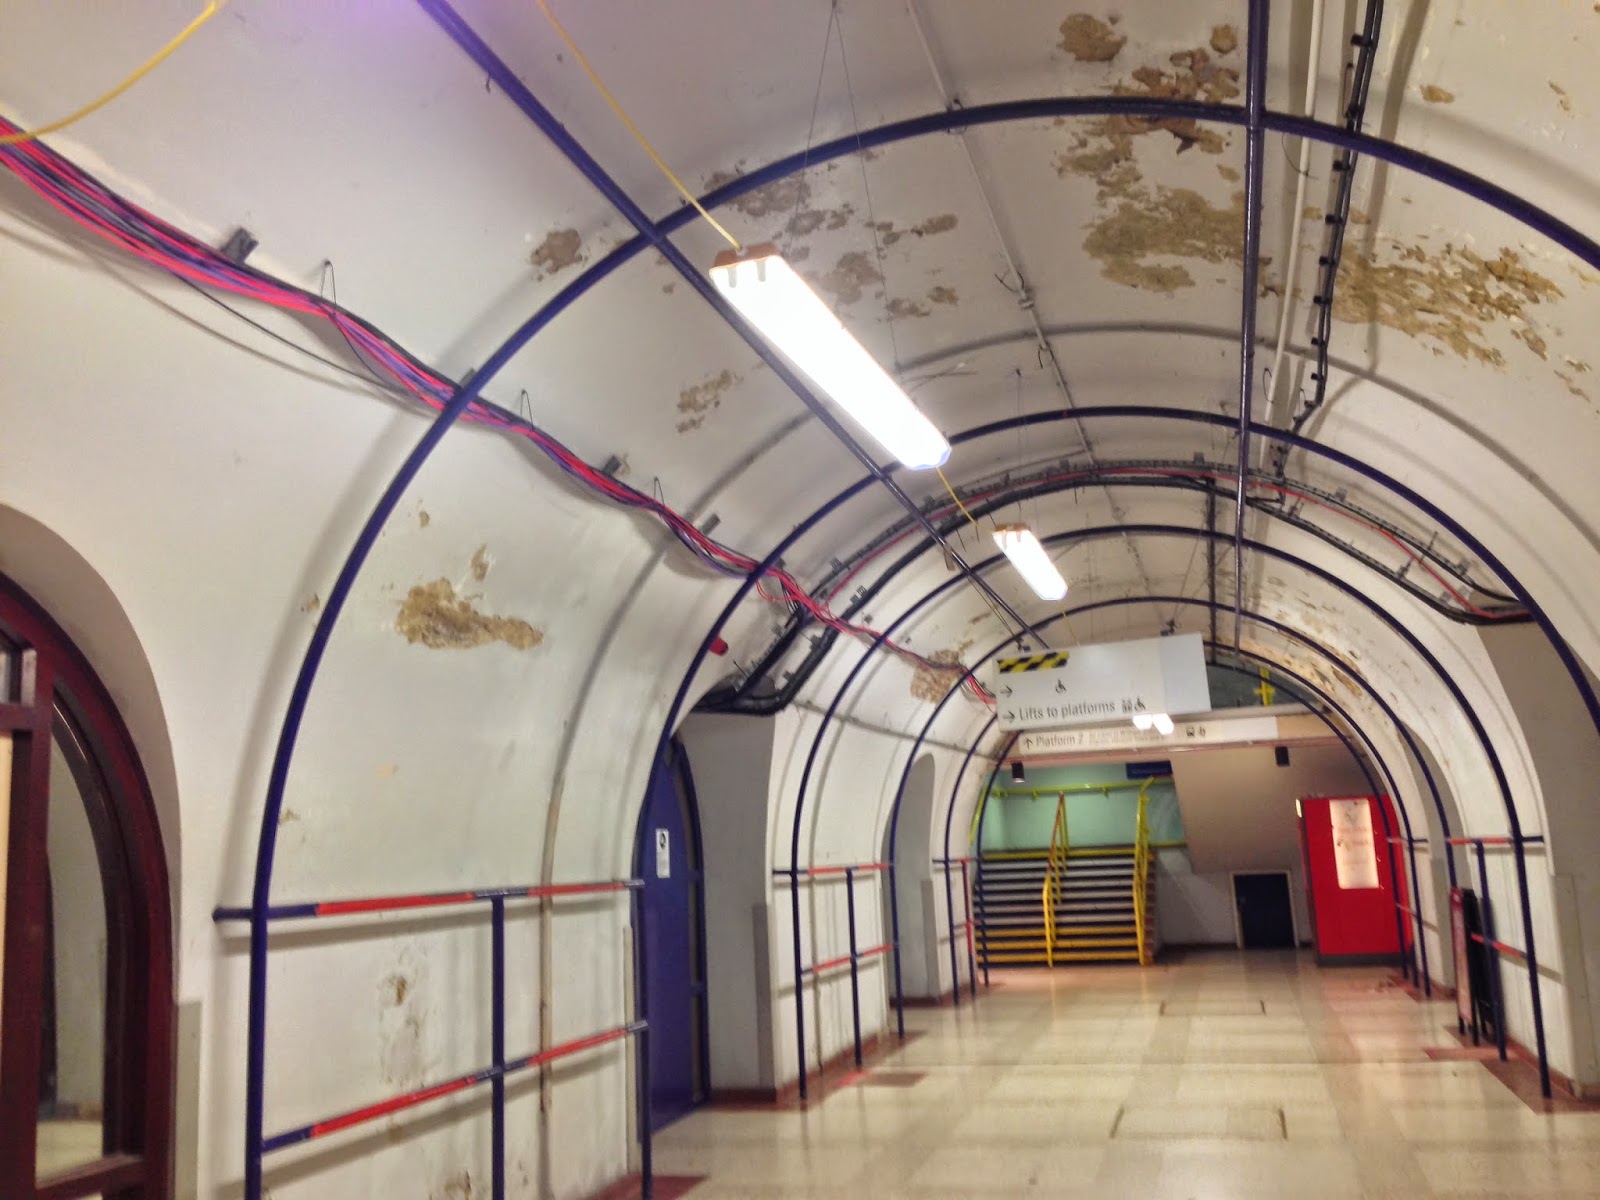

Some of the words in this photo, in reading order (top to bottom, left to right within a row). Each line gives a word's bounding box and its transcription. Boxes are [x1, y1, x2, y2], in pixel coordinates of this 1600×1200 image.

[1018, 706, 1044, 721] Lifts
[1046, 705, 1058, 718] to
[1061, 701, 1115, 719] platforms
[1035, 734, 1076, 747] Platform
